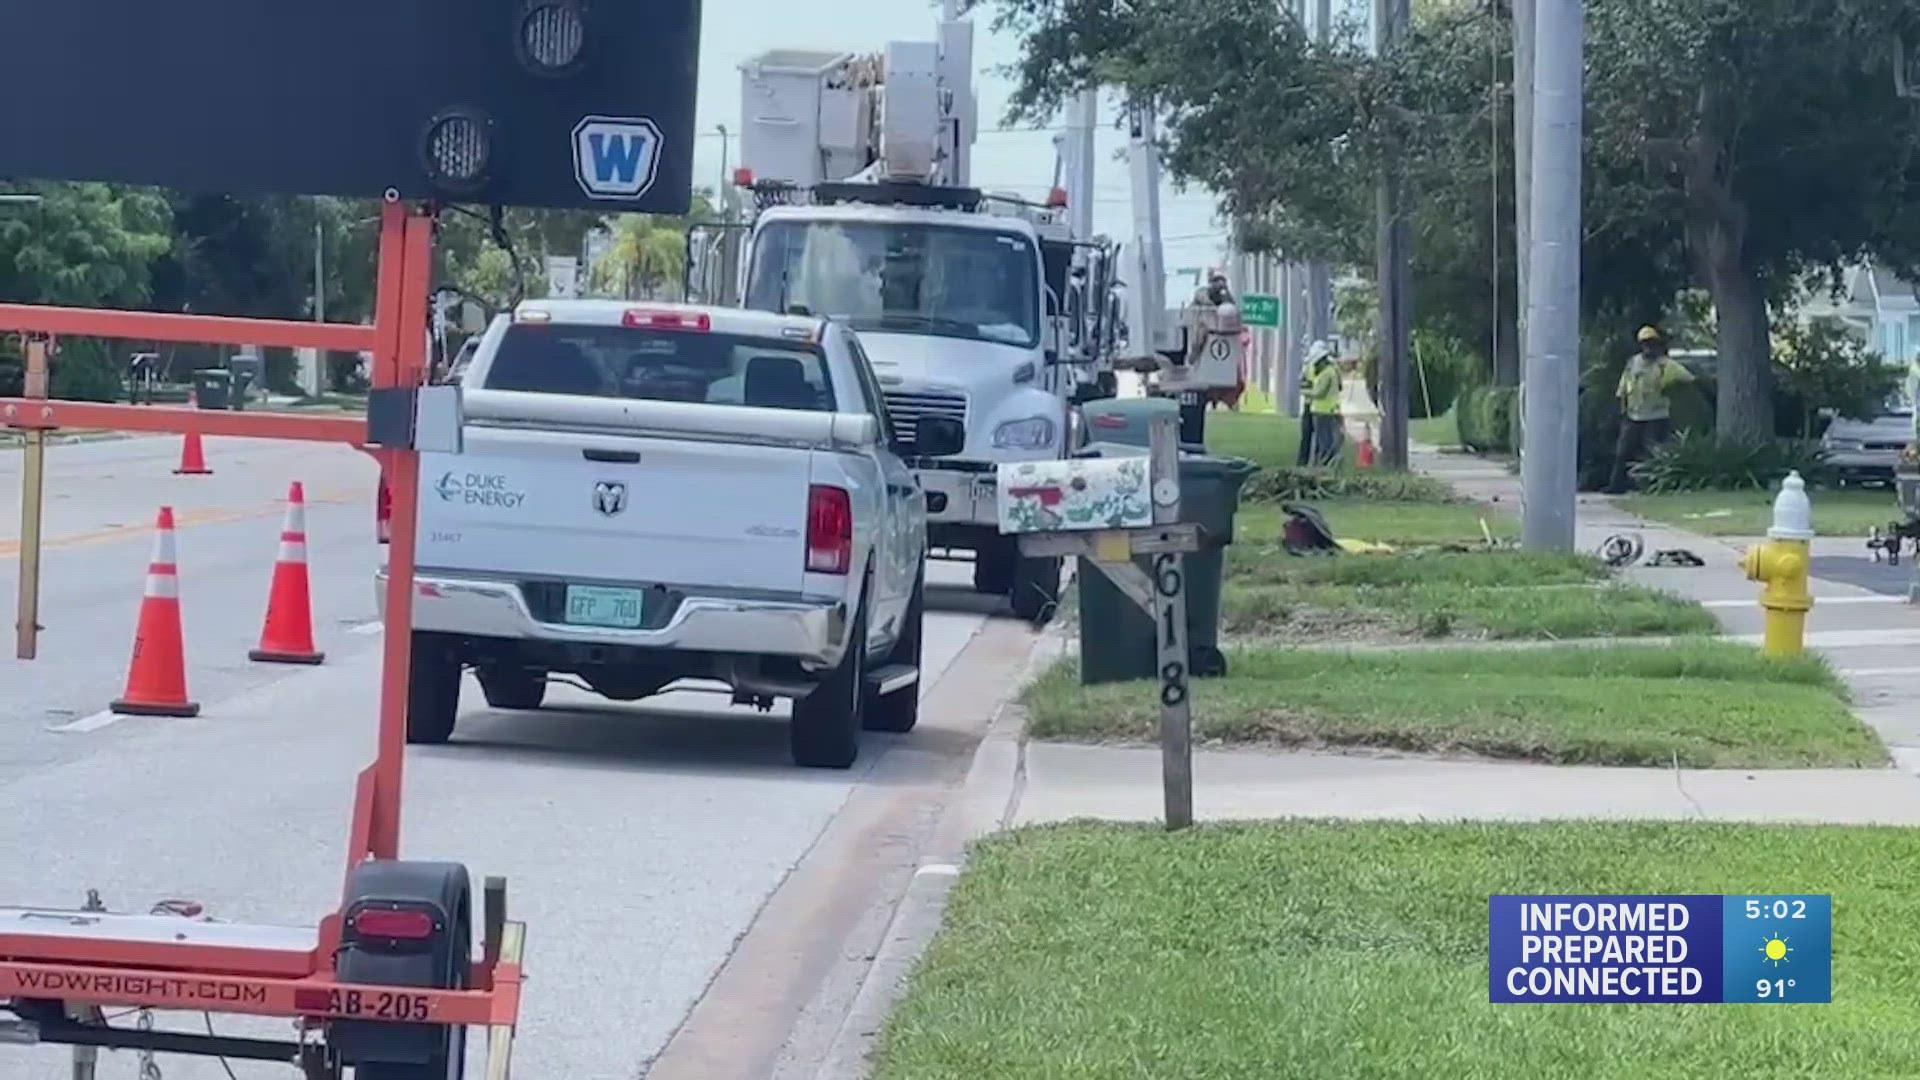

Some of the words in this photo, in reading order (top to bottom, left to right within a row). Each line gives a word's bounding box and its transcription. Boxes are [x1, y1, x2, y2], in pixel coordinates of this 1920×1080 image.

[587, 133, 646, 182] W
[465, 473, 506, 490] DUKE
[464, 489, 526, 508] ENERGY
[1155, 553, 1185, 707] 618
[15, 970, 267, 1004] WDWRIGHT.COM
[326, 988, 430, 1021] AB-205
